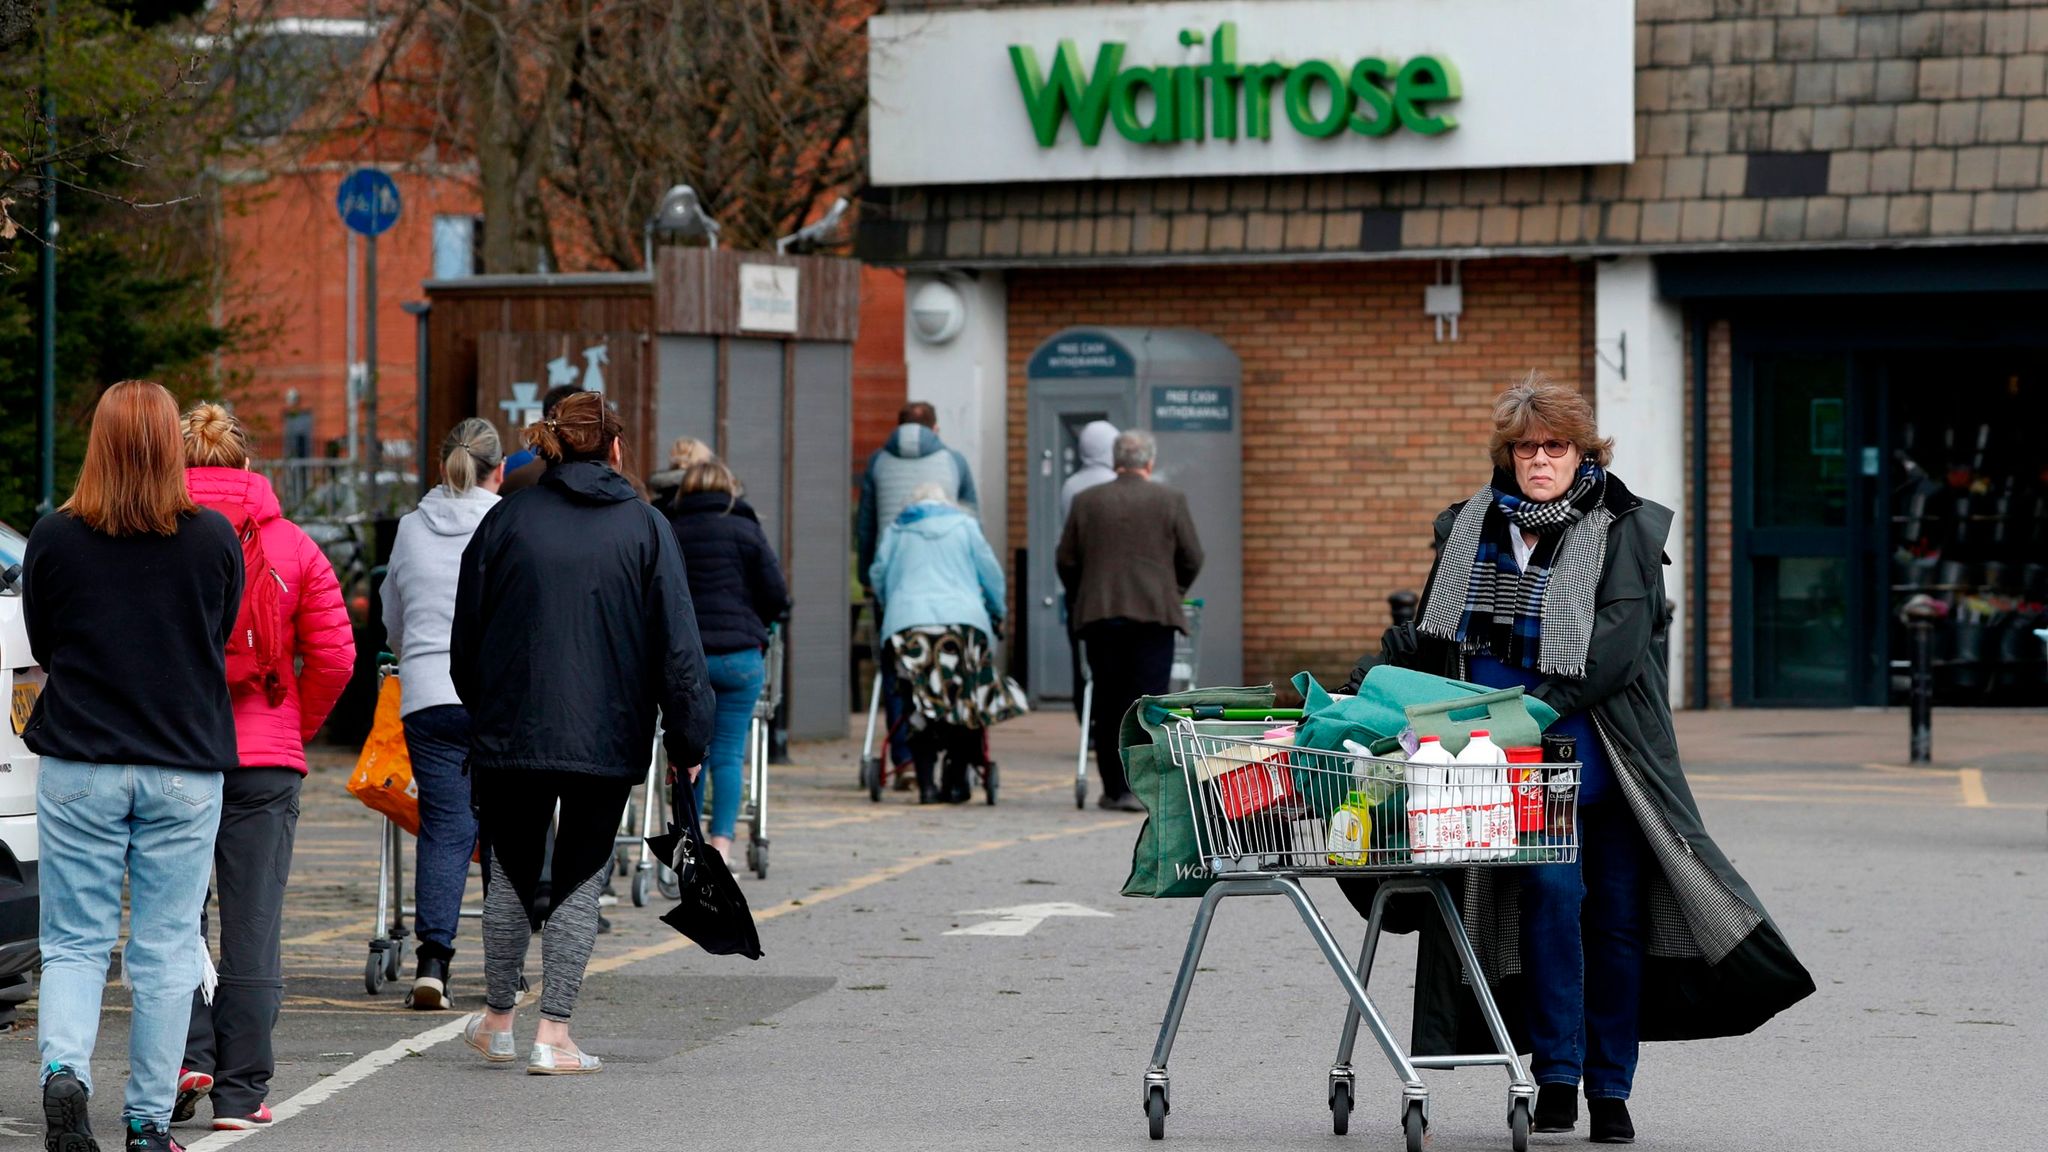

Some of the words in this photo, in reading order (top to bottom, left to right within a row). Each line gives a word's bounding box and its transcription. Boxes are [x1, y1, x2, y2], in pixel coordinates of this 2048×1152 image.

[1008, 21, 1462, 148] Waitrose
[1057, 342, 1079, 354] FREE
[1082, 342, 1106, 353] CASH
[1048, 355, 1116, 368] WITHDRAWALS
[1165, 390, 1189, 402] FREE
[1191, 390, 1218, 402] CASH
[1155, 406, 1229, 419] WITHDRAWALS
